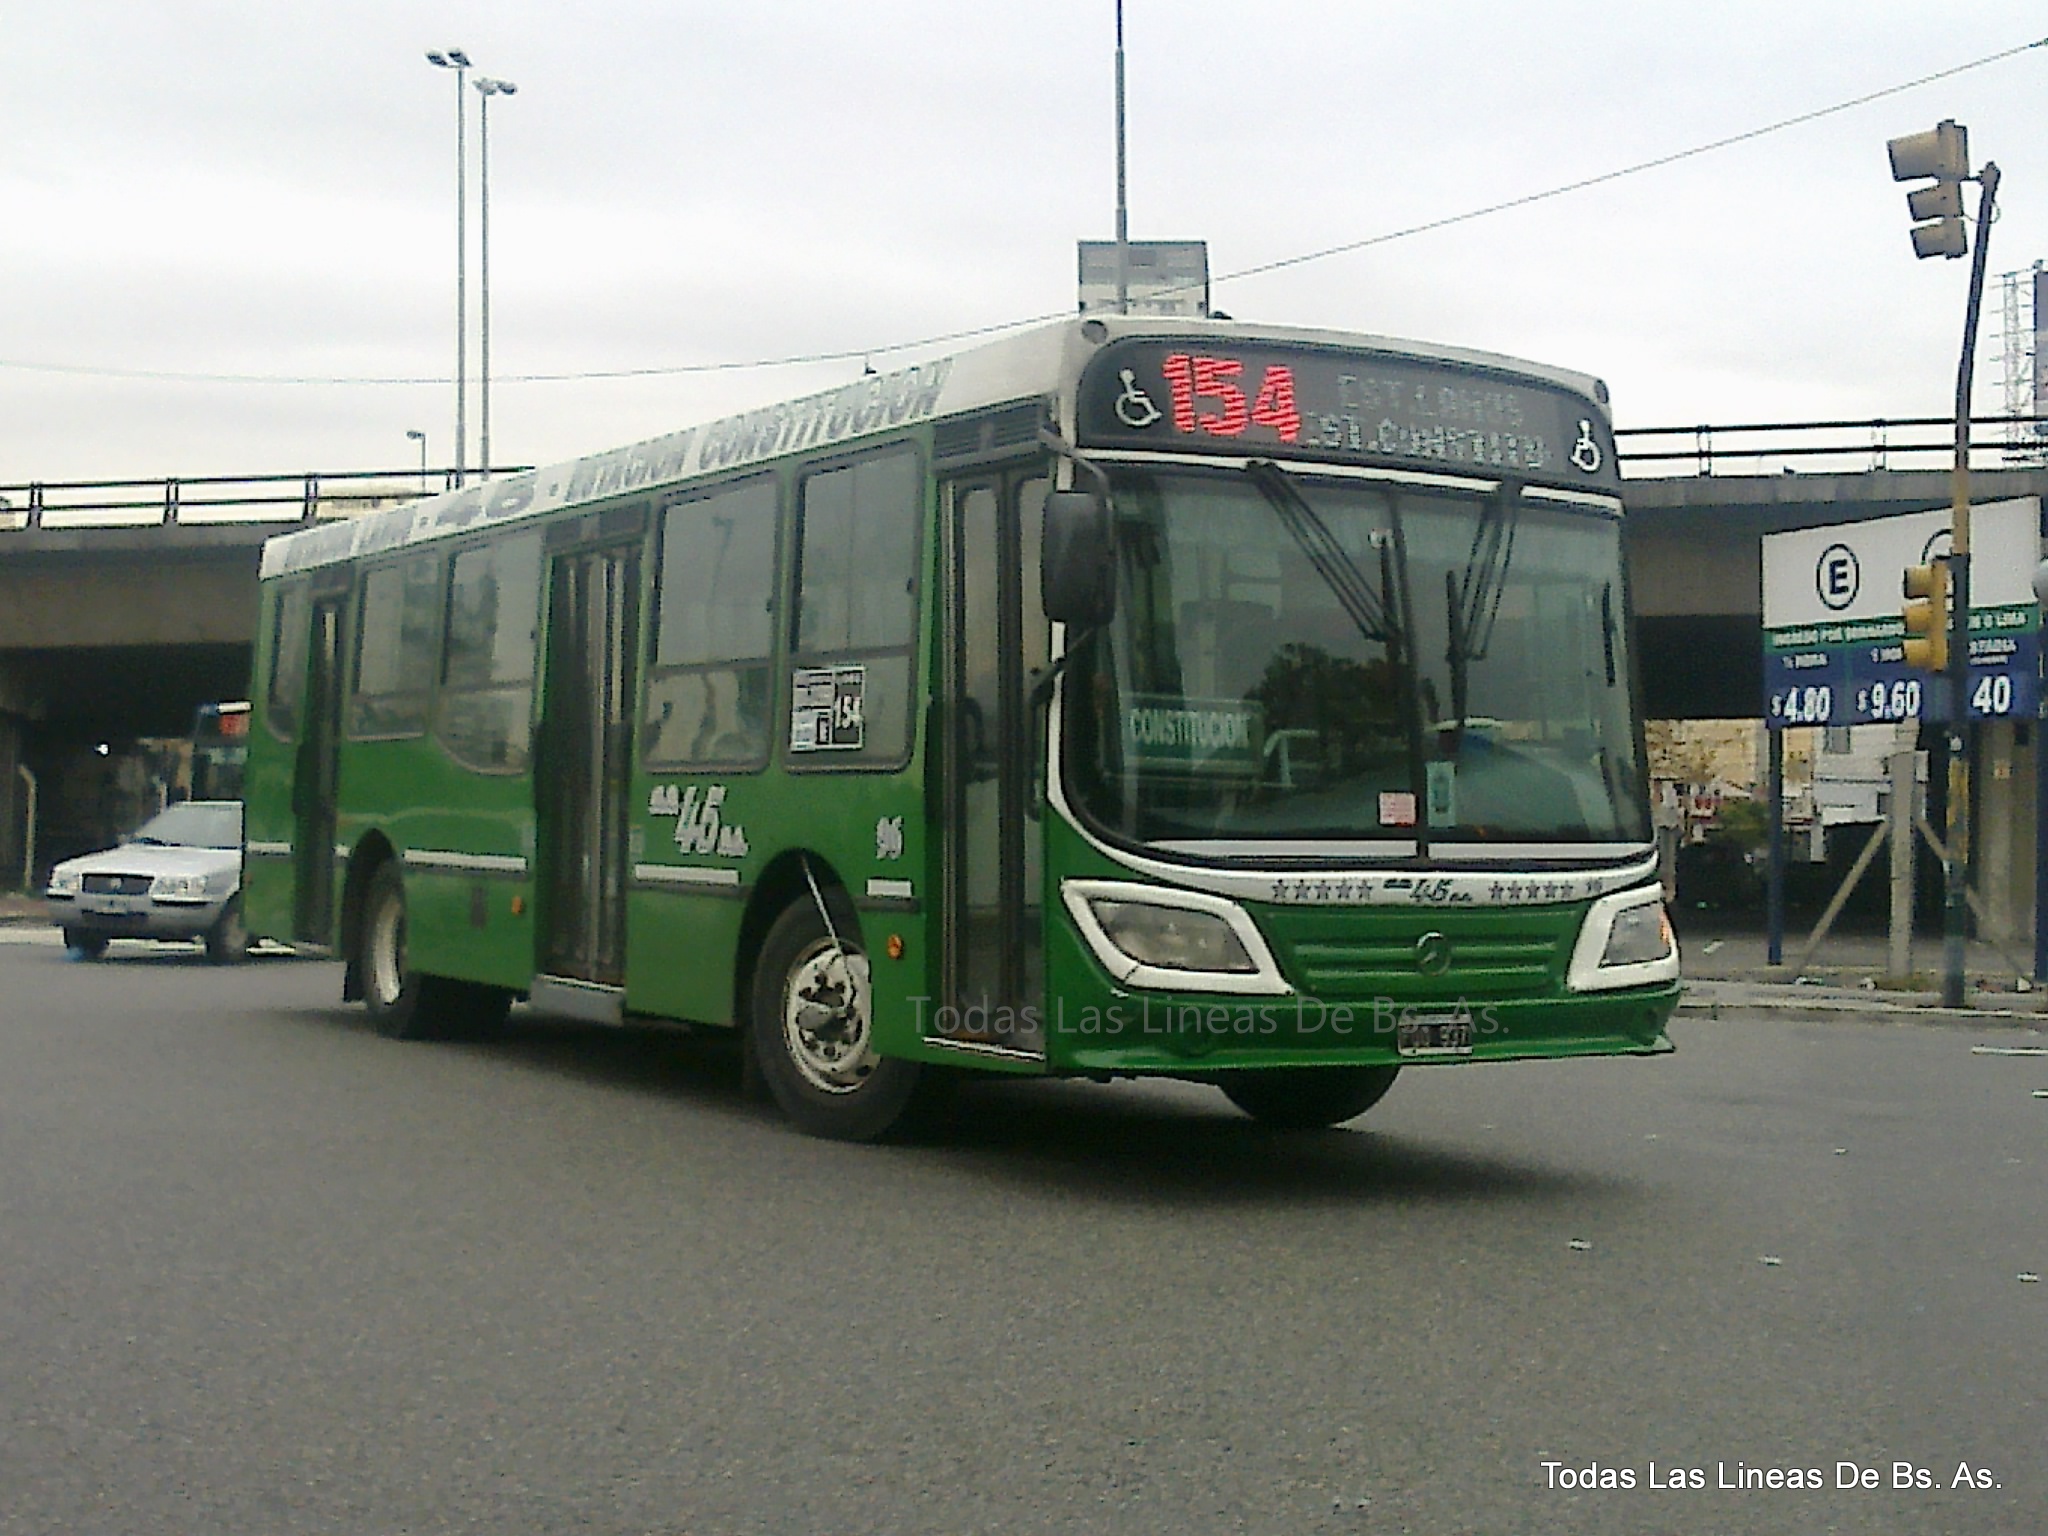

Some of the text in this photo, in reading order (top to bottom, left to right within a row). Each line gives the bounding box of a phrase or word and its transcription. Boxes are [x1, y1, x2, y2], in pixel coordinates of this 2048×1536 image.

[1163, 353, 1301, 443] 154
[1828, 558, 1848, 595] E
[1971, 675, 2012, 714] 40
